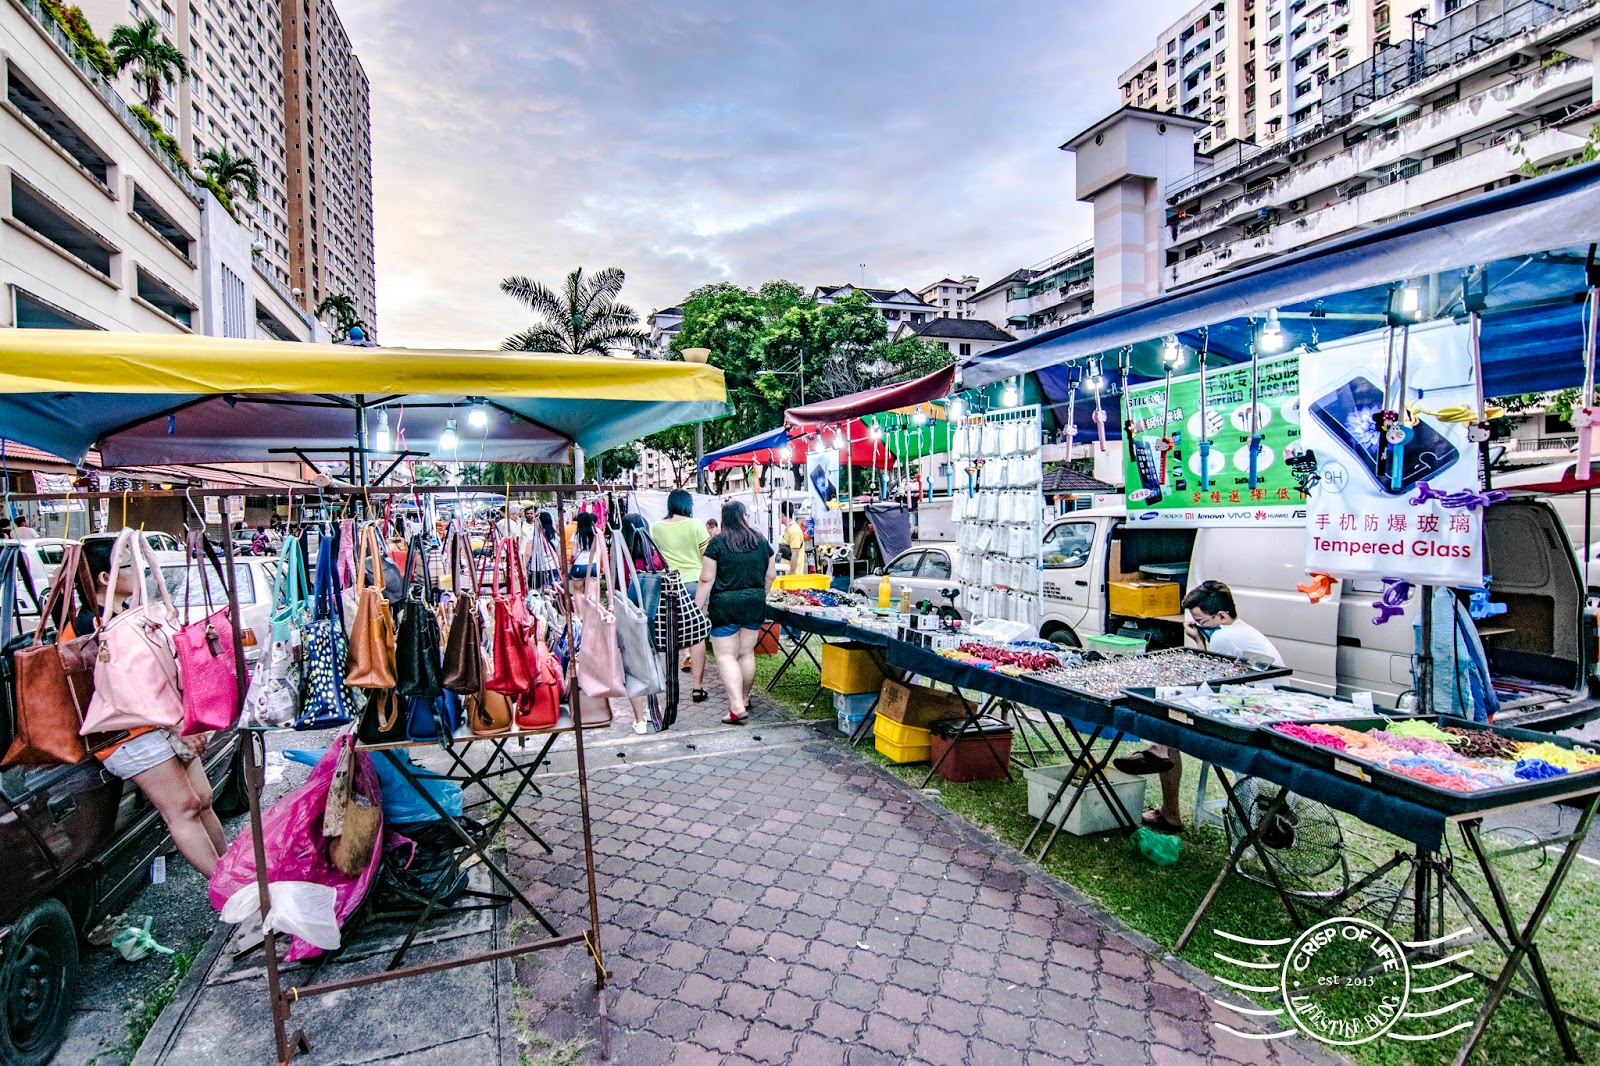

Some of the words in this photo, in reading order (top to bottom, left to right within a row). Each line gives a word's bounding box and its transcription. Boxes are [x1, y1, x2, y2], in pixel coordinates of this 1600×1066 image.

[1199, 389, 1243, 407] EMPERED
[1324, 471, 1343, 485] 9H
[1315, 512, 1471, 533] 手机防爆玻璃
[1313, 536, 1404, 556] Tempered
[1411, 540, 1471, 558] Glass
